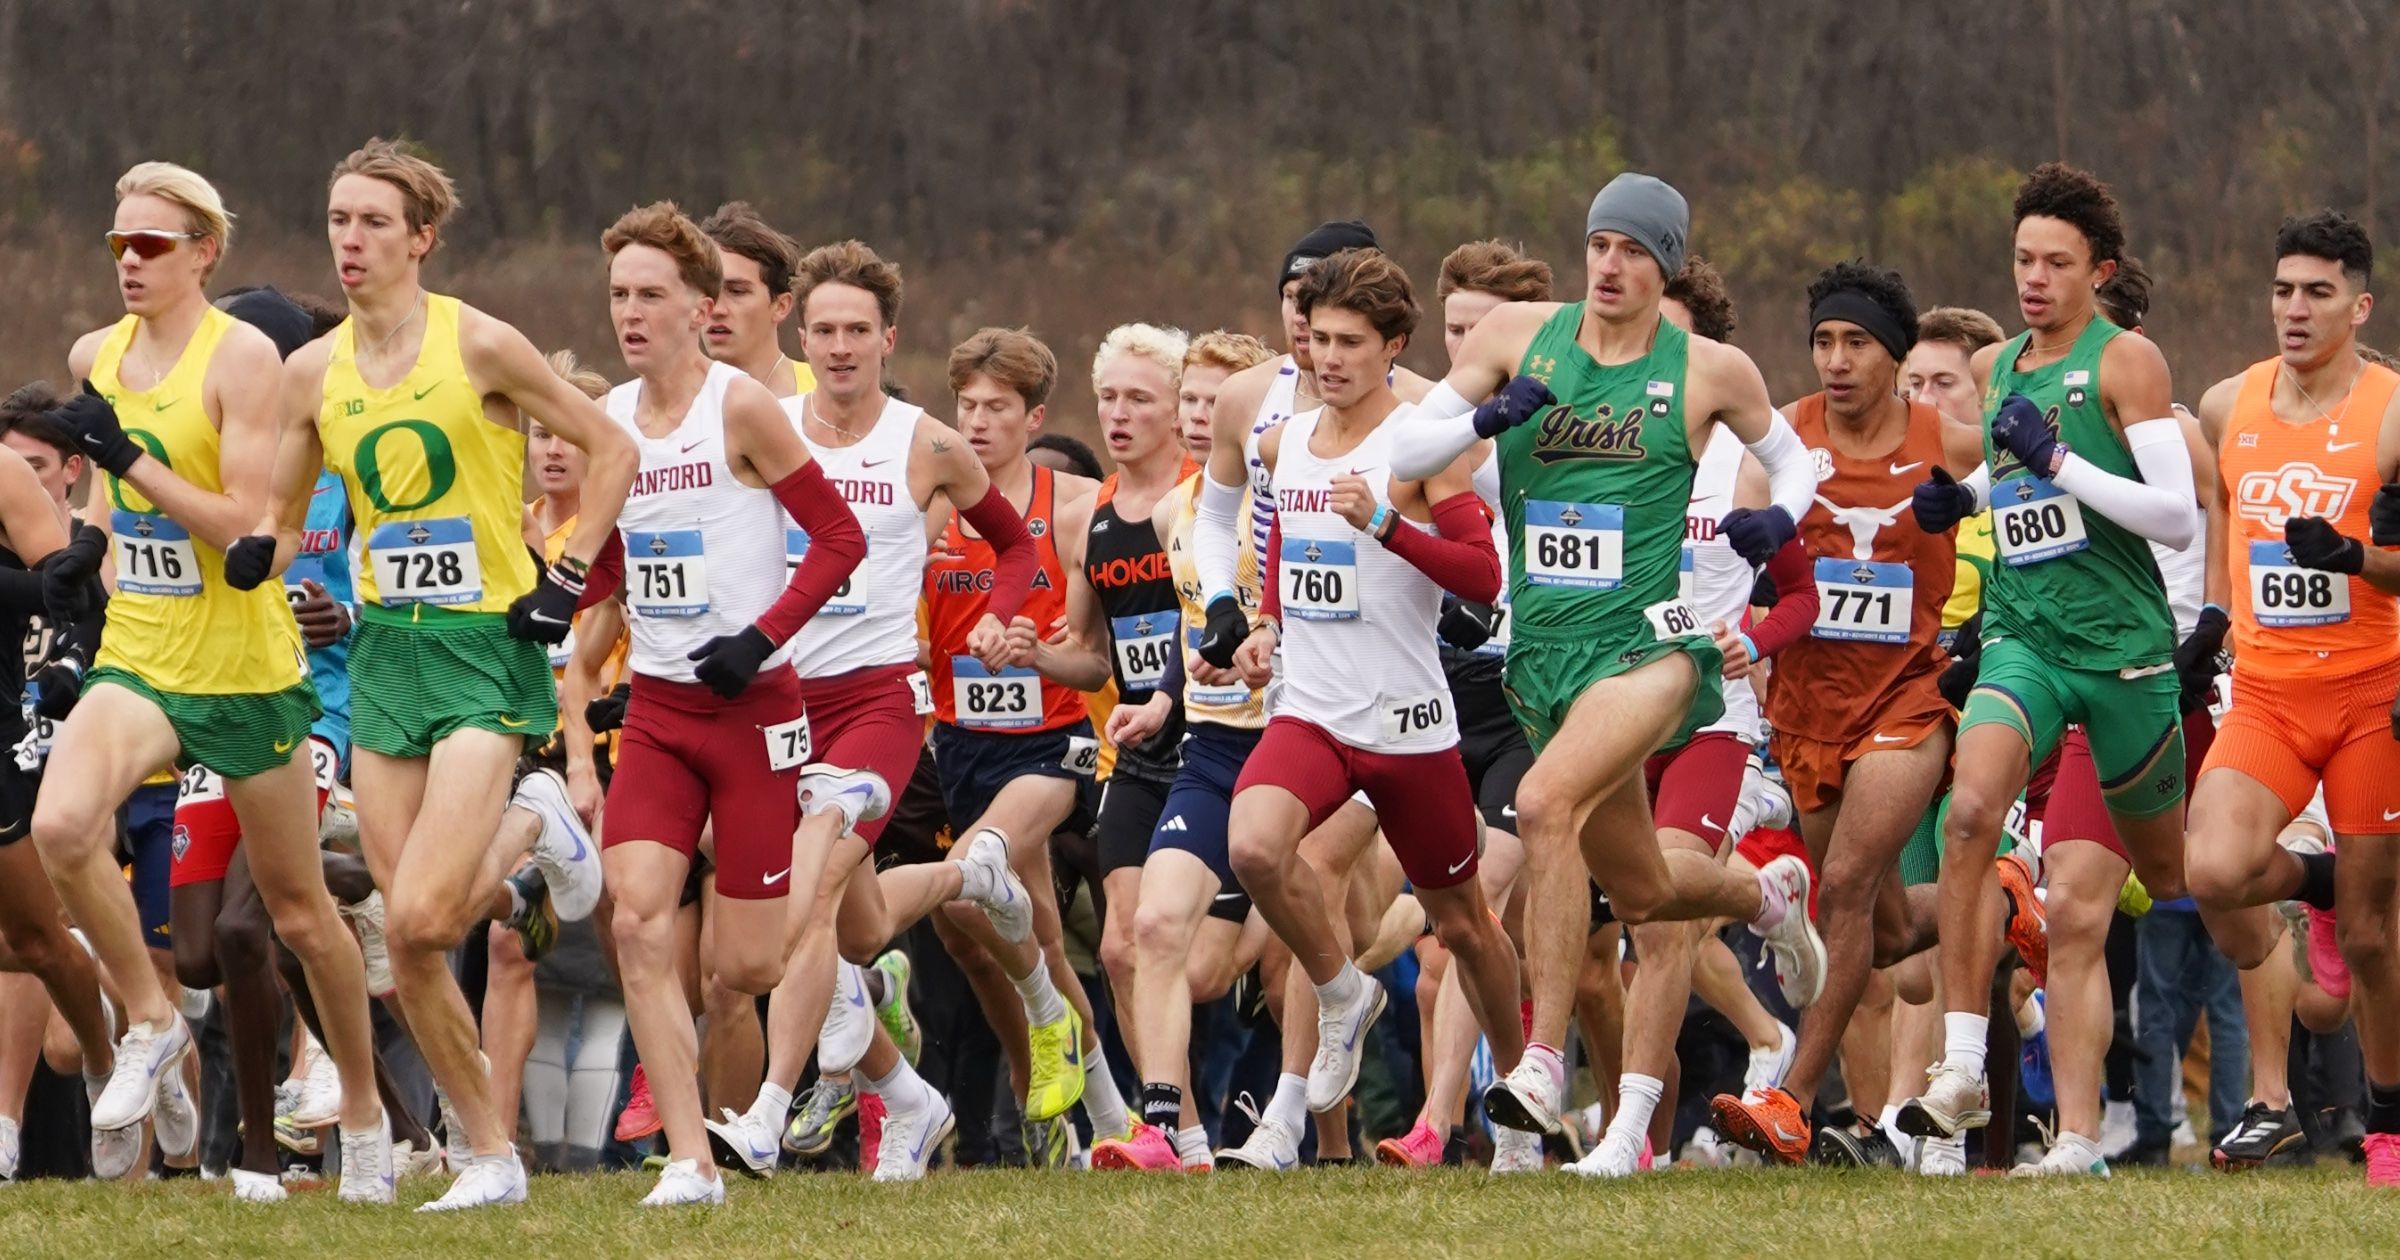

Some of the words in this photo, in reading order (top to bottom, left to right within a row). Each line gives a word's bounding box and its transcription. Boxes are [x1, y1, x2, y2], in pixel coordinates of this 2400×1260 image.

[1652, 403, 1667, 413] AB
[2069, 392, 2083, 403] AB
[1534, 402, 1646, 460] Irish
[353, 418, 456, 513] O
[628, 461, 712, 497] ANFORD
[2237, 462, 2358, 532] OSU
[2004, 503, 2066, 547] 680
[123, 541, 182, 579] 716
[387, 550, 463, 589] 728
[1538, 532, 1599, 571] 681
[638, 562, 686, 599] 751
[930, 566, 1053, 593] VIRGA
[1289, 568, 1343, 604] 760
[2262, 572, 2333, 609] 698
[1827, 588, 1892, 625] 771
[967, 682, 1027, 713] 823
[1393, 697, 1442, 734] 760
